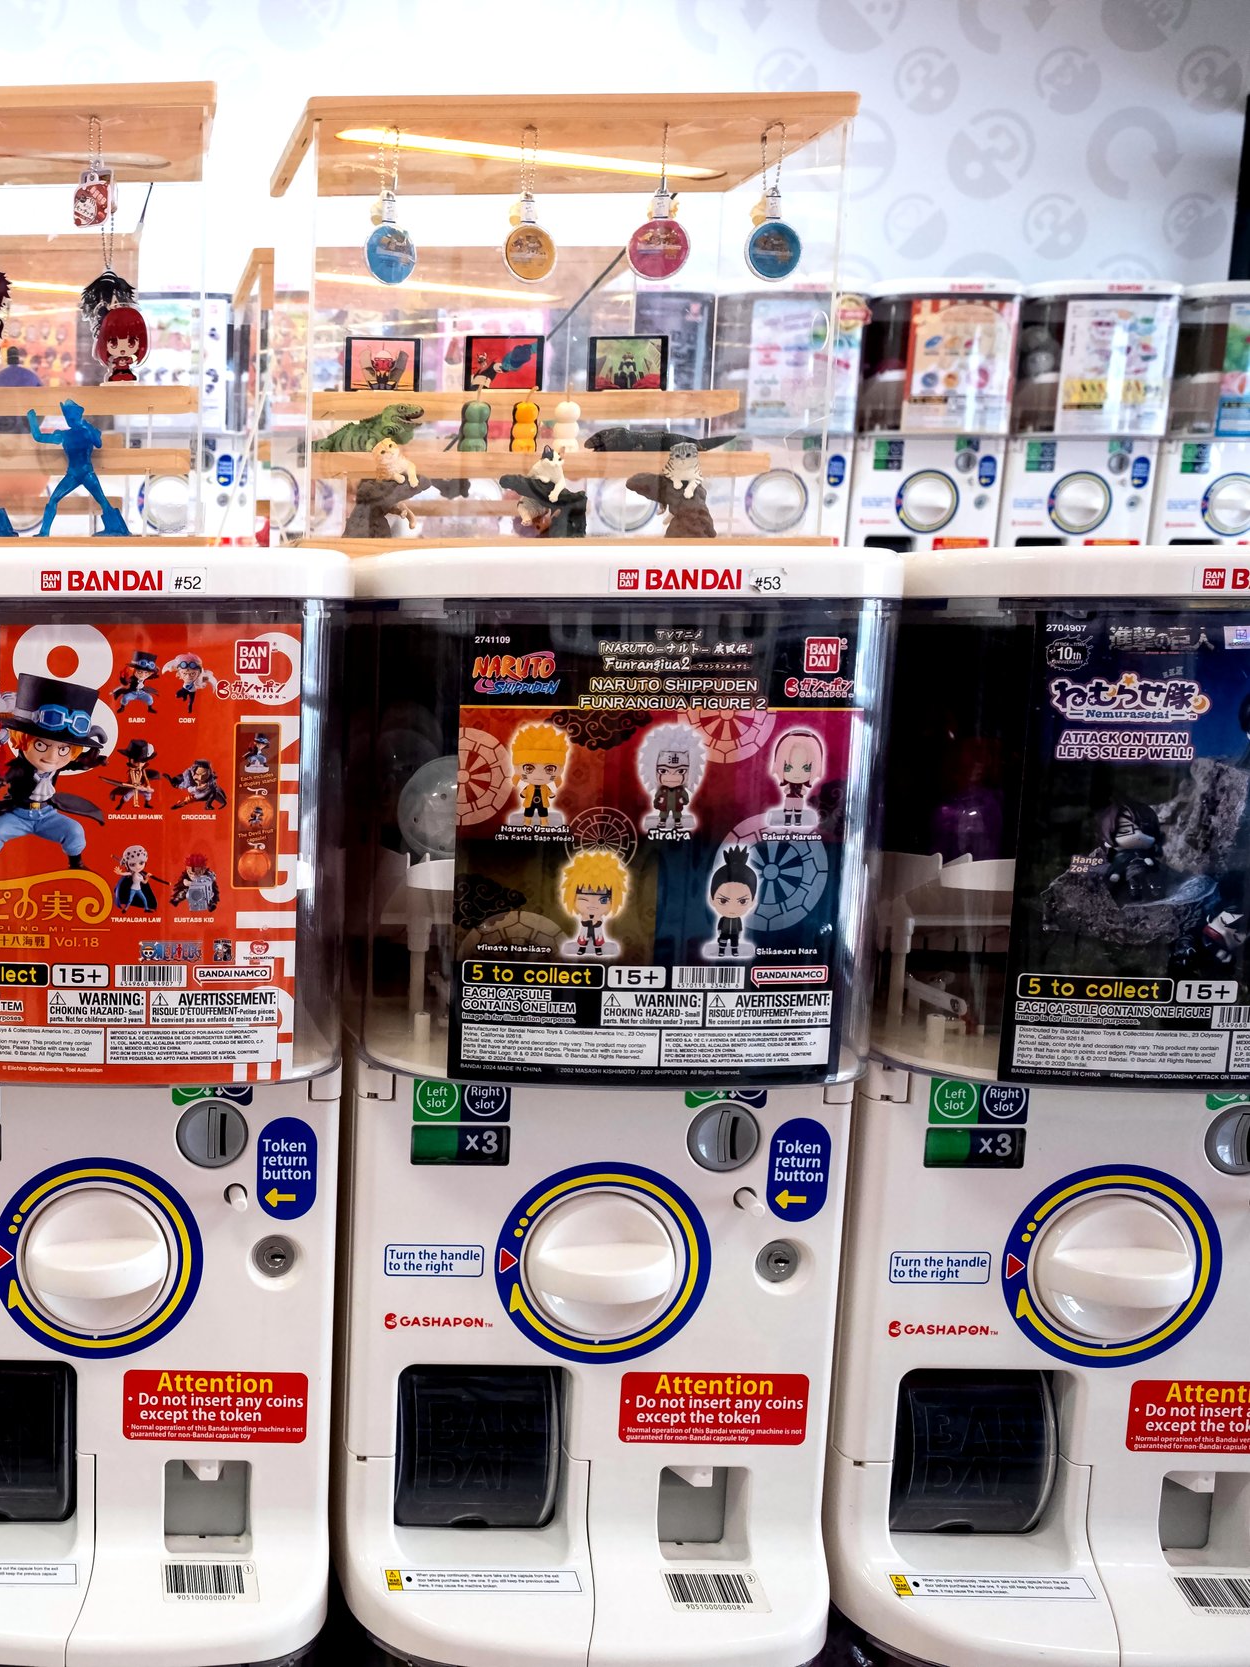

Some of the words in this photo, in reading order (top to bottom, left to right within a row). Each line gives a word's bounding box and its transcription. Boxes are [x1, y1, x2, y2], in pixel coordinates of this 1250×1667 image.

[67, 570, 163, 591] BANDAI
[174, 575, 202, 591] #52
[645, 569, 742, 590] BANDAI
[755, 576, 781, 591] #53
[1046, 624, 1087, 632] 2704907
[474, 636, 511, 644] 2741109
[239, 646, 267, 658] BAN
[239, 658, 261, 670] DAI
[472, 654, 556, 680] NARUTO
[231, 681, 286, 694] ガシャポン
[489, 679, 561, 695] SHIPPUDEN
[590, 679, 661, 693] NARUTO
[664, 678, 759, 693] SHIPPUDEN
[800, 677, 855, 692] ガシャポン
[1054, 681, 1196, 710] ねむらせ隊
[579, 697, 686, 710] FUNRANGIUA
[691, 697, 751, 711] FIGURE
[755, 698, 766, 711] 2
[1086, 710, 1170, 719] Nemurasetai
[1062, 733, 1119, 744] ATTACK
[1121, 733, 1142, 744] ON
[1145, 733, 1188, 745] TITAN
[668, 754, 680, 765] 油
[1101, 747, 1146, 759] SLEEP
[1150, 747, 1193, 760] WELL!
[648, 830, 691, 842] Jiraiya
[1072, 855, 1104, 866] Hange
[1070, 864, 1089, 873] Zoë
[55, 937, 100, 948] Vol.18
[59, 968, 102, 984] 15+
[199, 970, 233, 978] BANDAI
[234, 969, 268, 977] NAMCO
[1028, 978, 1041, 994] 5
[1051, 979, 1075, 996] to
[1086, 981, 1159, 999] collect
[1184, 984, 1230, 1000] 15+
[79, 992, 144, 1006] WARNING:
[178, 992, 277, 1006] AVERTISSEMENT:
[50, 1006, 88, 1015] CHOKING
[90, 1007, 128, 1016] HAZARD-
[152, 1007, 179, 1016] RISQUE
[262, 1139, 308, 1153] Token
[979, 1133, 1013, 1157] x3
[262, 1154, 308, 1167] return
[262, 1167, 312, 1182] button
[904, 1323, 989, 1336] GASHAPON
[157, 1372, 274, 1394] Attention
[655, 1375, 774, 1395] Attention
[139, 1393, 159, 1406] Do
[162, 1394, 187, 1406] not
[191, 1394, 232, 1407] insert
[236, 1397, 262, 1410] any
[266, 1395, 304, 1408] coins
[140, 1410, 189, 1423] except
[192, 1409, 217, 1421] the
[220, 1410, 262, 1422] token
[231, 1426, 257, 1434] vending
